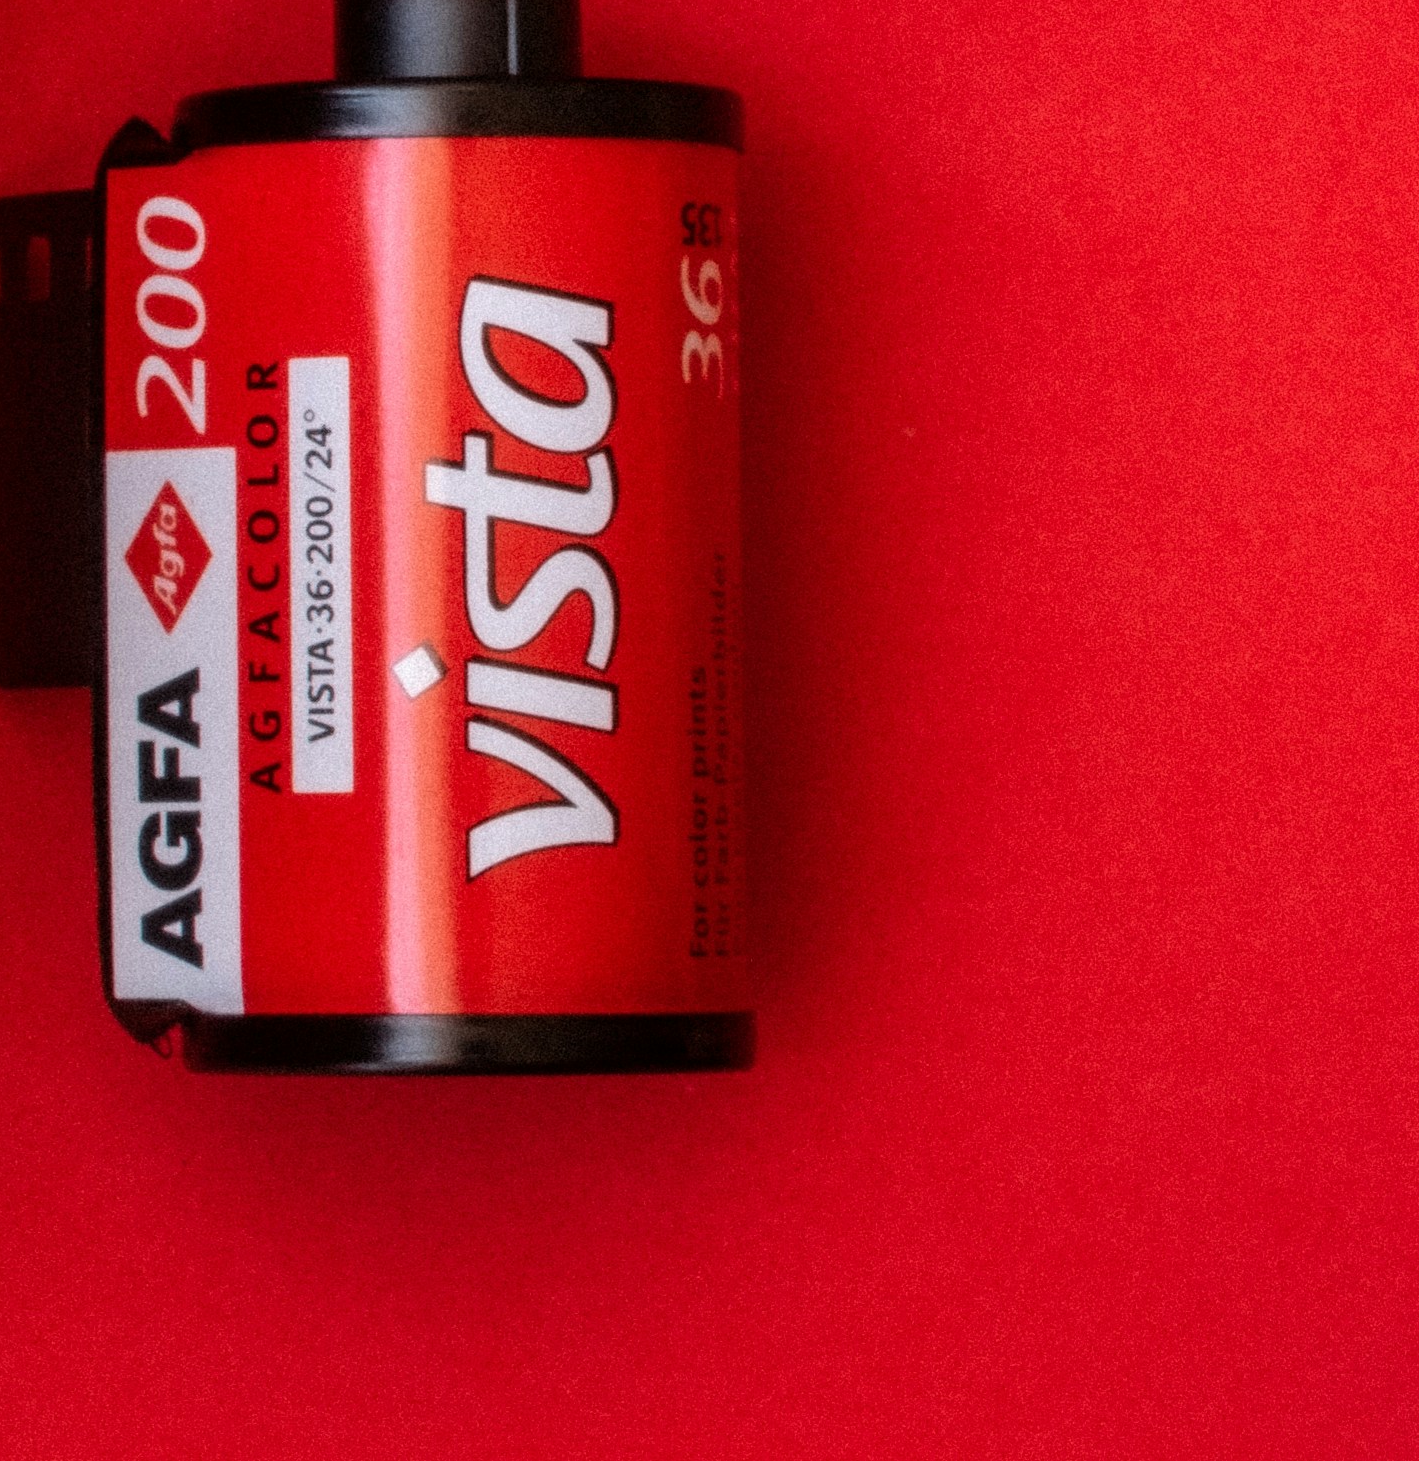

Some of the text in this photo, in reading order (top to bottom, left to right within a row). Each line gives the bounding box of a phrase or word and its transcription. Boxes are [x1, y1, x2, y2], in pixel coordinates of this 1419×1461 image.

[680, 254, 723, 399] 36
[135, 195, 207, 970] AGFA Agfa 200
[246, 360, 282, 794] AGFACOLOR
[392, 275, 620, 882] vista
[688, 666, 712, 958] For color prints
